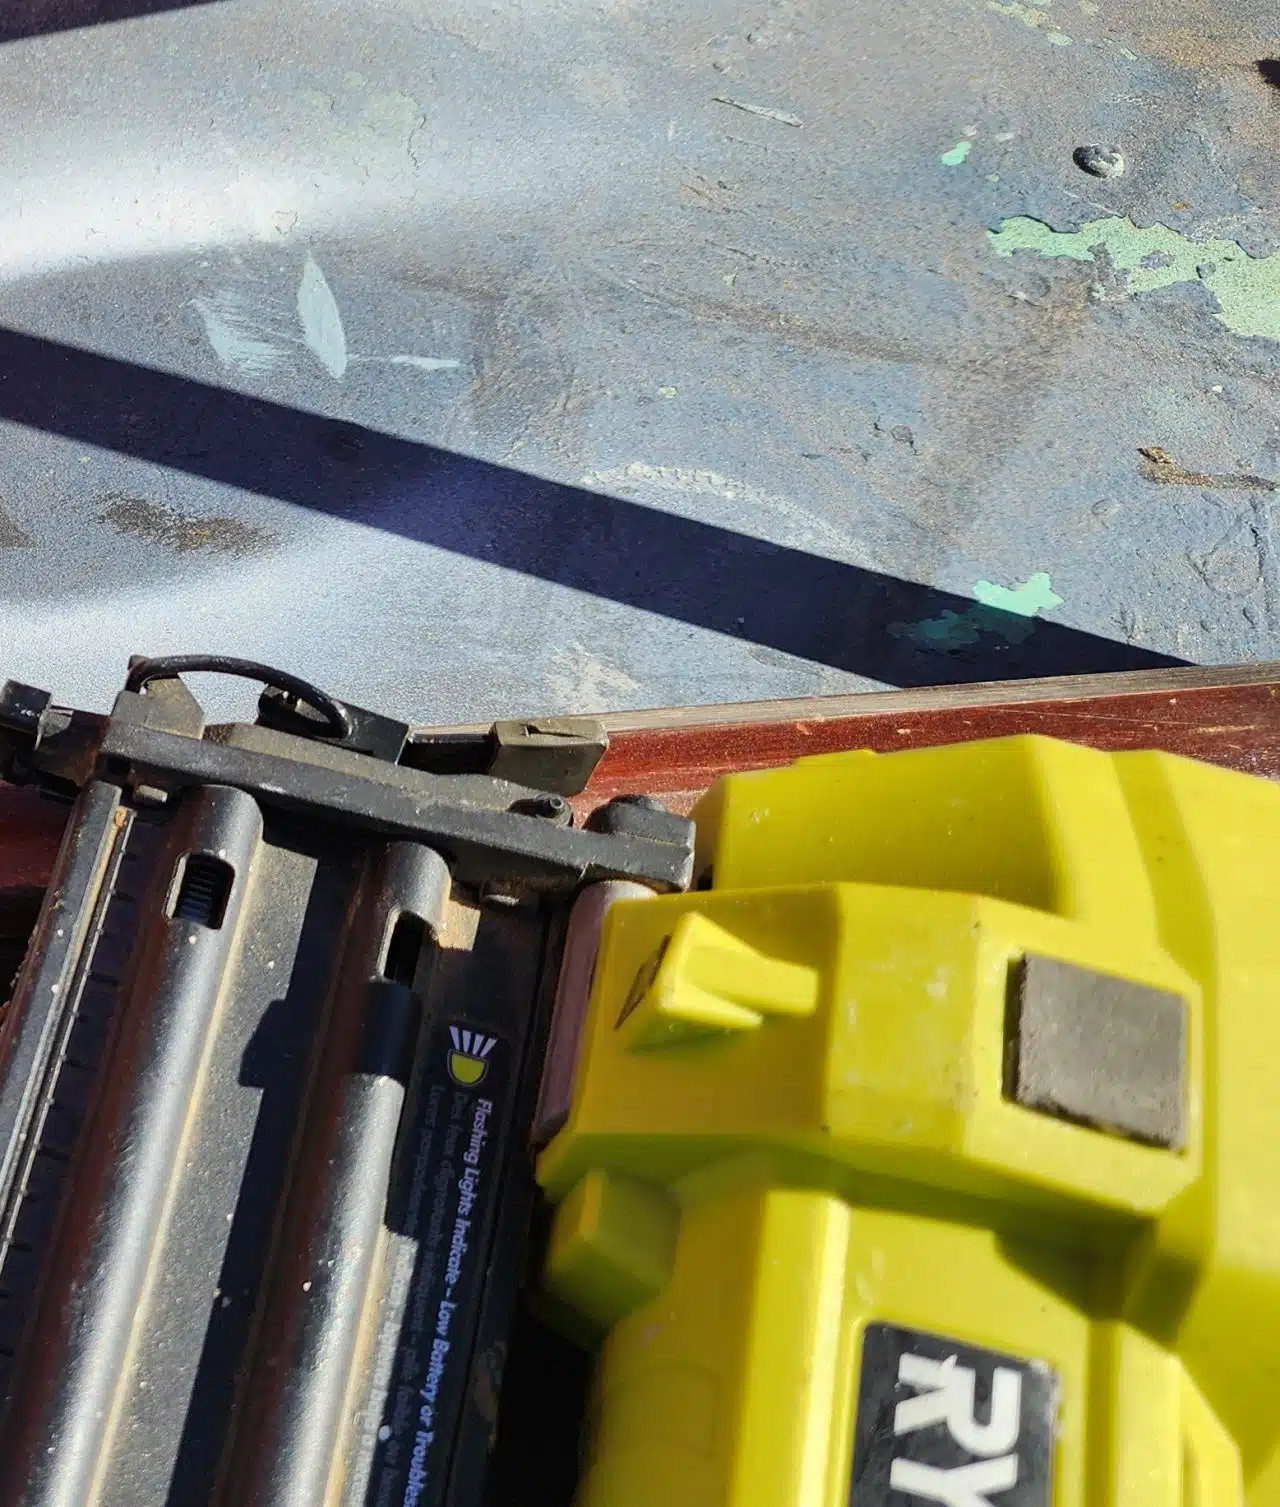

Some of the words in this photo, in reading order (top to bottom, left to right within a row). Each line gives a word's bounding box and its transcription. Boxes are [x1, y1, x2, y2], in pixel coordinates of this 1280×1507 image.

[463, 1097, 492, 1164] Flashing
[456, 1167, 480, 1217] Lights
[445, 1218, 471, 1285] Indicate
[436, 1300, 457, 1336] Low
[419, 1338, 451, 1403] Battery
[419, 1404, 434, 1427] or
[402, 1430, 435, 1507] Troubles
